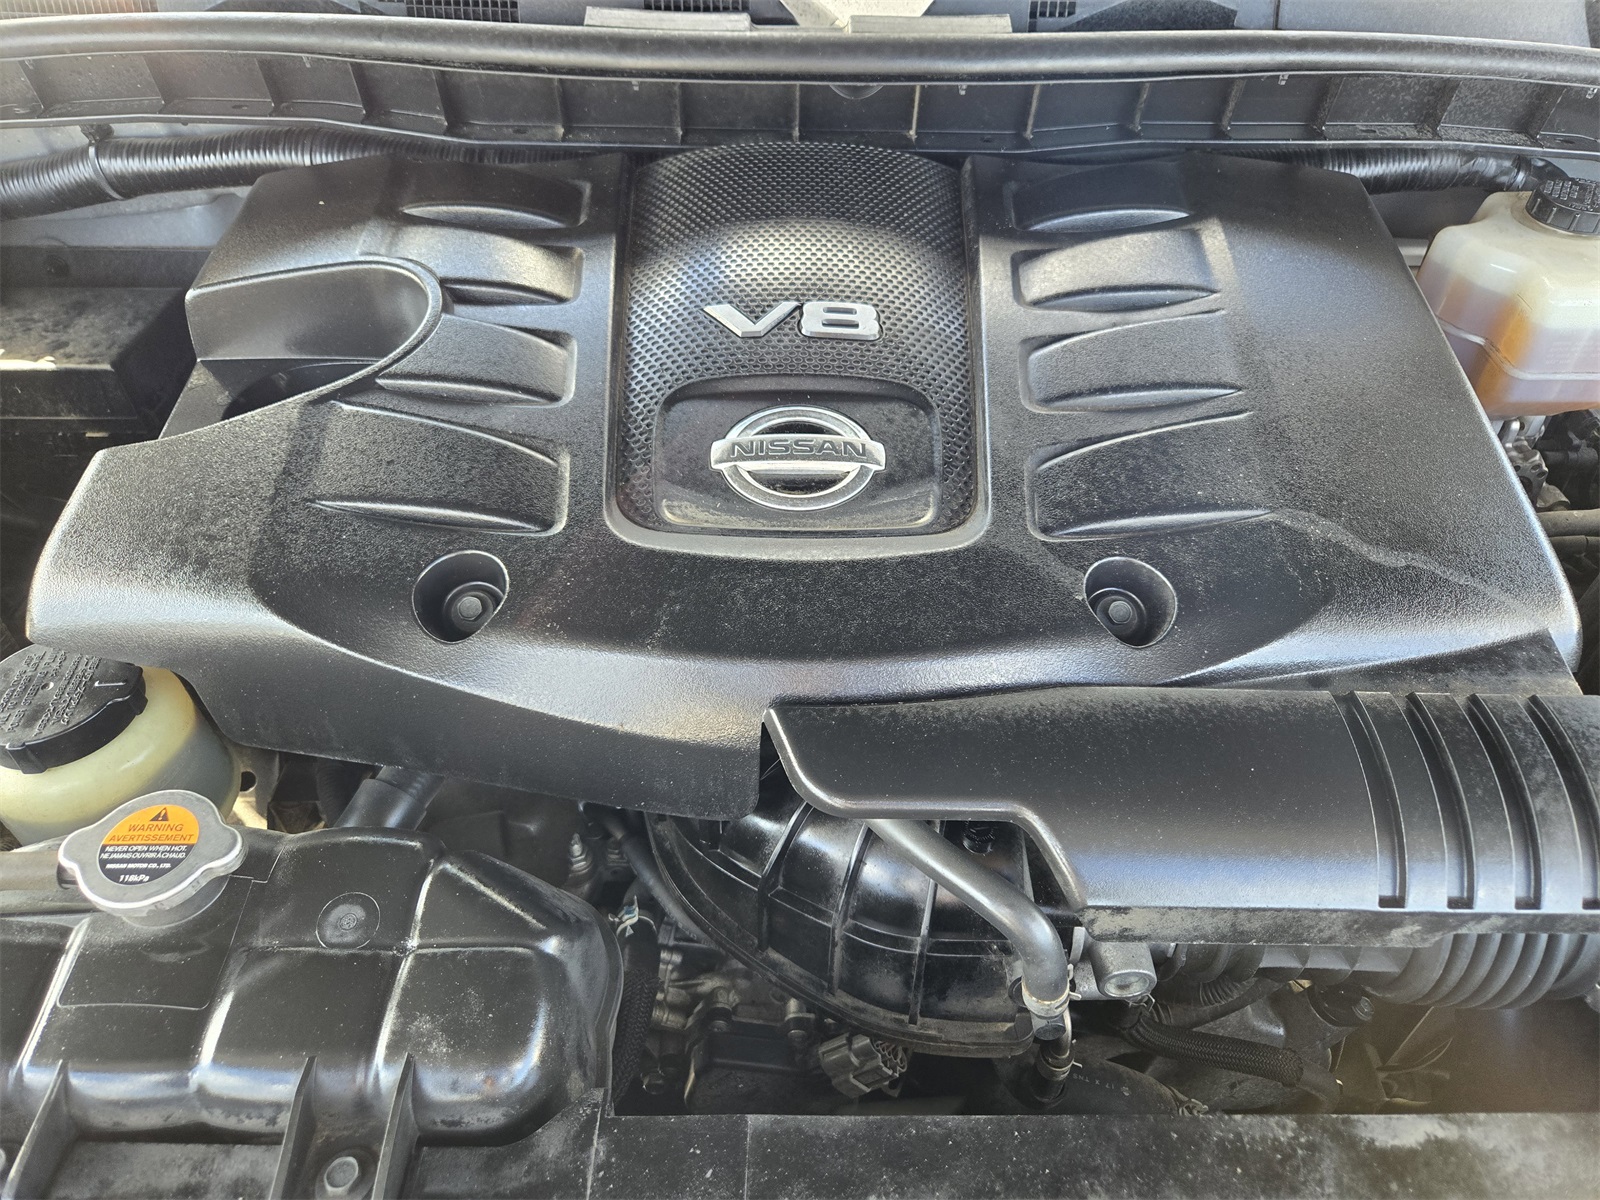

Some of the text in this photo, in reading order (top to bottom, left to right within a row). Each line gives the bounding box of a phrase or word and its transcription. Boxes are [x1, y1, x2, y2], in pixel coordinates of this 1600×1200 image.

[703, 301, 883, 340] V8
[729, 439, 868, 458] NISSAN
[128, 823, 184, 832] WARNING
[109, 834, 194, 842] AVERTISSEMENT
